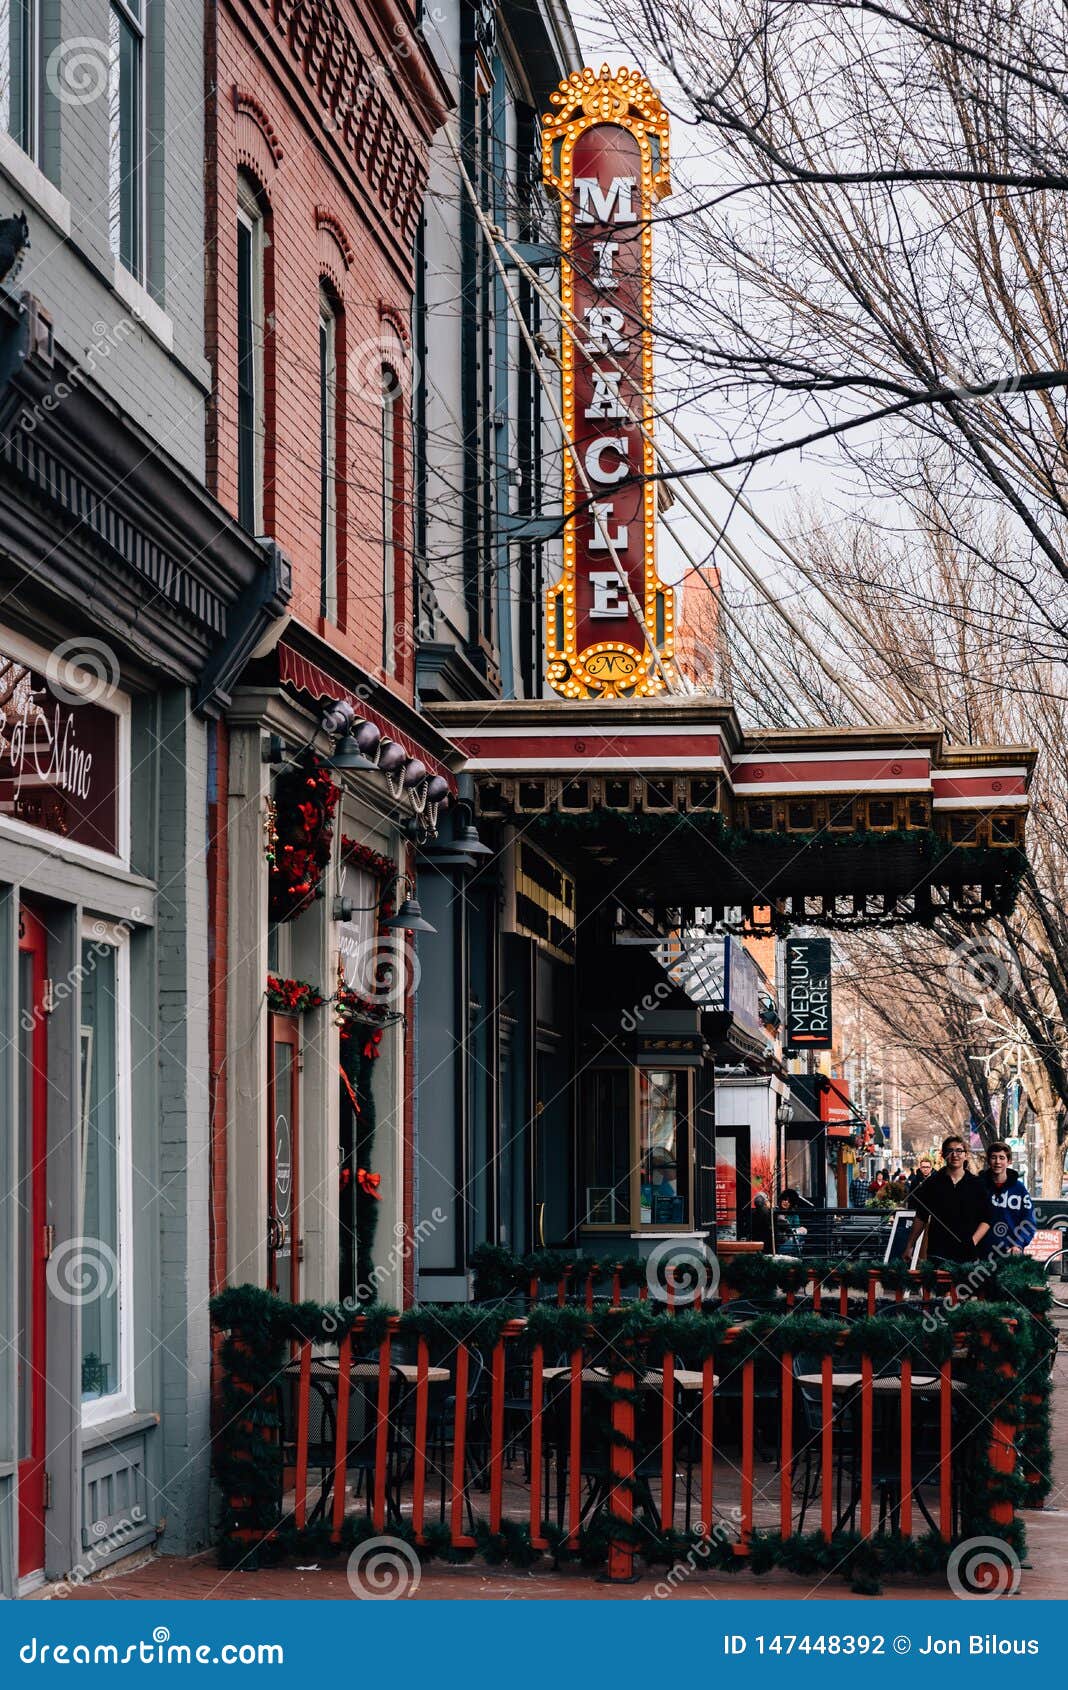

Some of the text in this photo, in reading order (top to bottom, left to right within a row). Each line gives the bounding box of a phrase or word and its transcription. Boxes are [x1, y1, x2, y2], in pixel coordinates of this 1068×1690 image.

[574, 176, 638, 618] MIRACLE
[34, 703, 92, 800] Mine
[791, 946, 810, 1031] MEDIUM
[810, 978, 829, 1031] RARE
